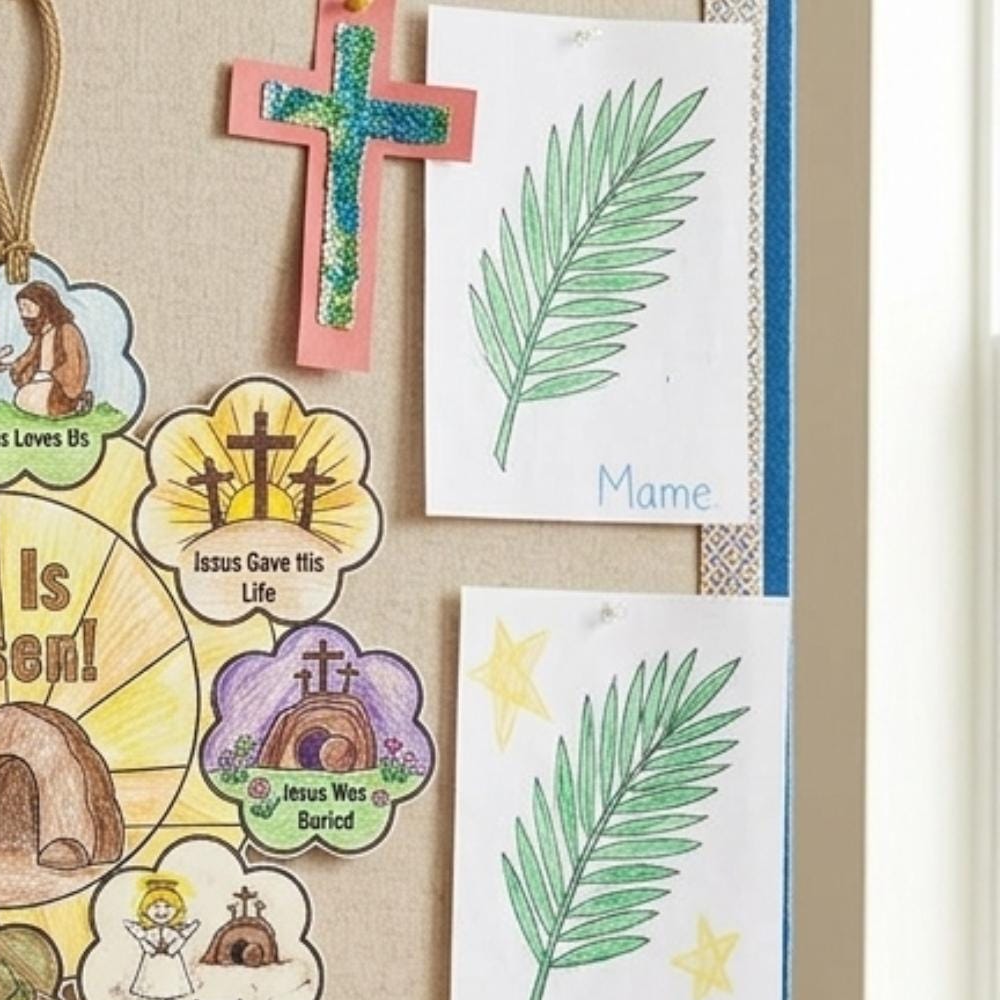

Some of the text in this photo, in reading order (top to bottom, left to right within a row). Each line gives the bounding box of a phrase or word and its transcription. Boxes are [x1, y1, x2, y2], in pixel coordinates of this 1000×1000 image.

[598, 464, 712, 511] Mame
[246, 551, 290, 573] Gave
[20, 548, 71, 611] Is
[242, 582, 276, 603] Life
